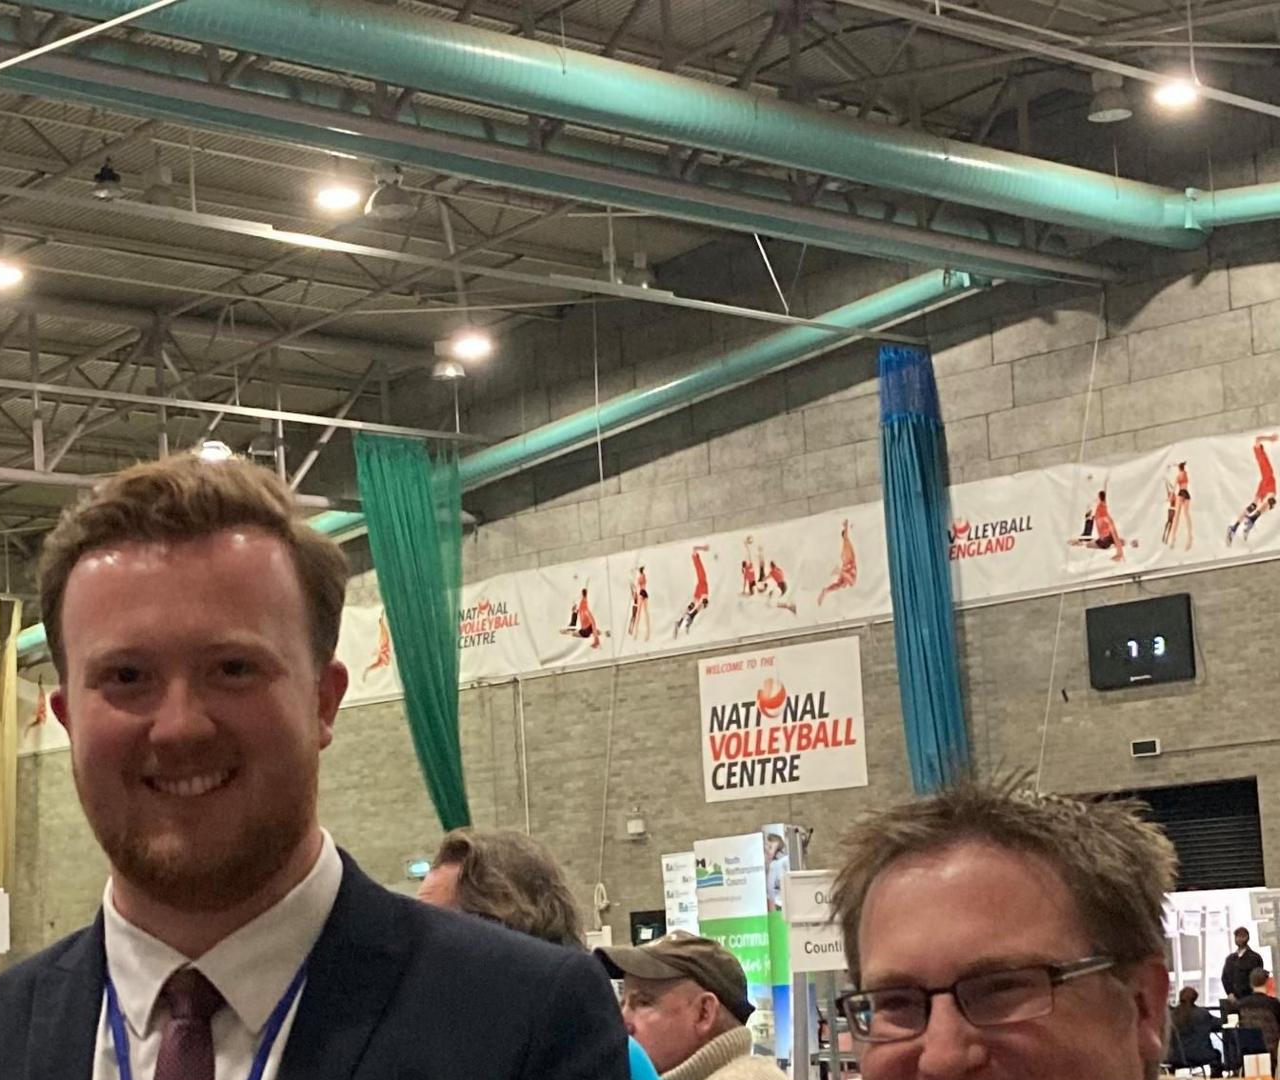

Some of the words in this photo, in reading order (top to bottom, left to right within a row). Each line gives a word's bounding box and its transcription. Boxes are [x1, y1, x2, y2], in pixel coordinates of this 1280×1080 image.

[948, 535, 1015, 561] ENGLAND
[458, 613, 520, 635] VOLLEYBALL
[458, 630, 496, 649] CENTRE
[705, 660, 744, 675] WELCOME
[746, 658, 758, 669] TO
[760, 656, 776, 668] THE
[709, 717, 857, 762] VOLLEYBALL
[711, 754, 801, 791] CENTRE
[814, 890, 833, 905] Ou
[804, 940, 843, 954] Counti
